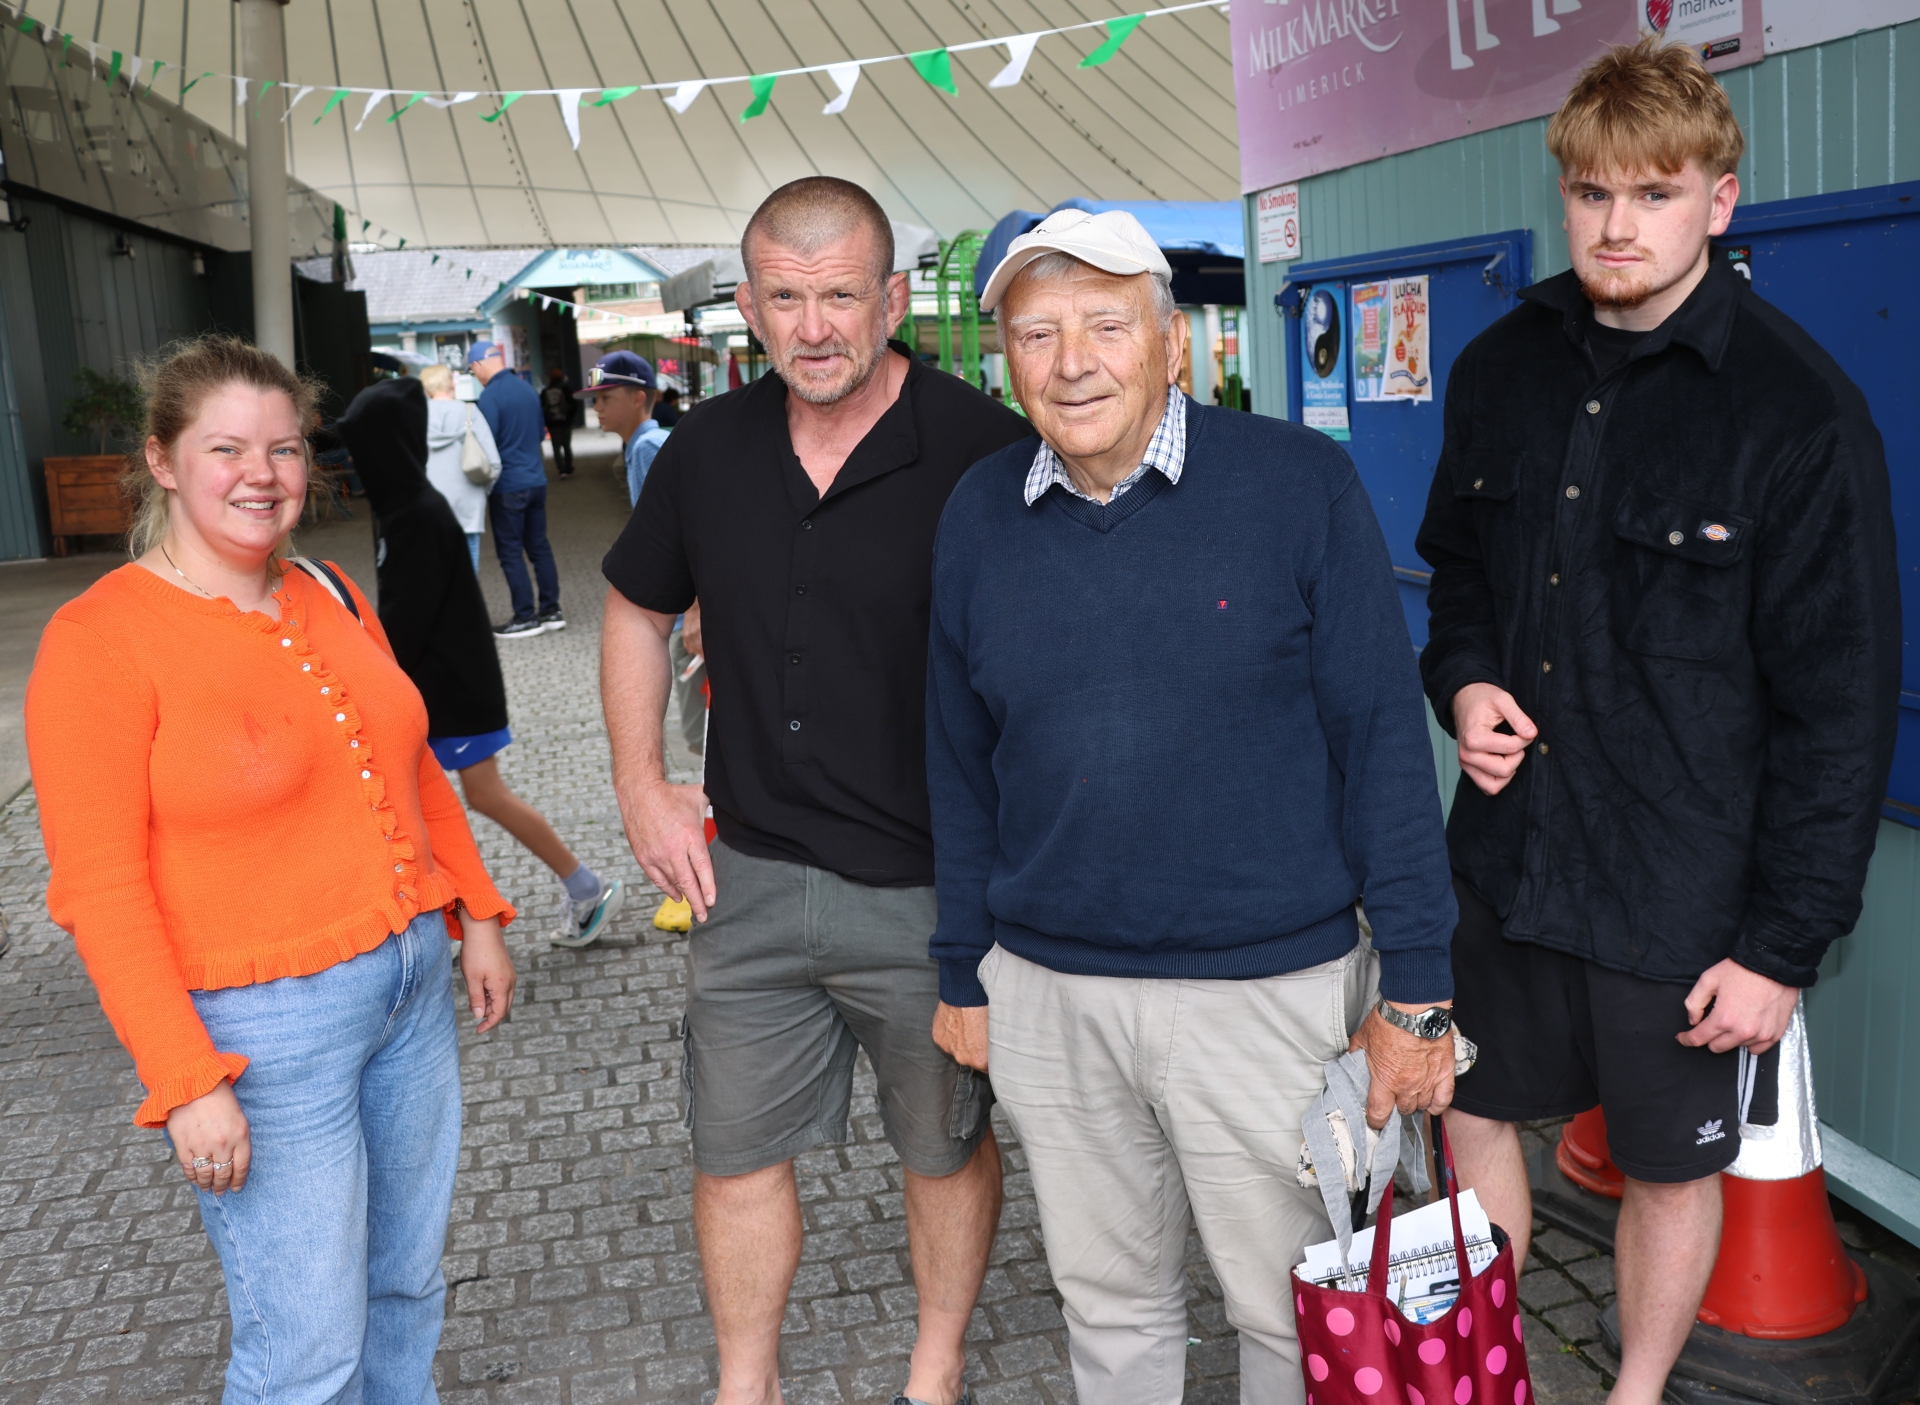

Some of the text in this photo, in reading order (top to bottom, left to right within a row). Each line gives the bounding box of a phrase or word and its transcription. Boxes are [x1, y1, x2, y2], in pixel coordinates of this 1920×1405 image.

[1679, 0, 1733, 17] mark
[1712, 40, 1739, 52] PRECISION
[1278, 61, 1366, 111] LIMERICK
[1259, 188, 1297, 211] No Smoking
[1395, 281, 1422, 299] LUCHA
[1696, 1131, 1726, 1145] adidas
